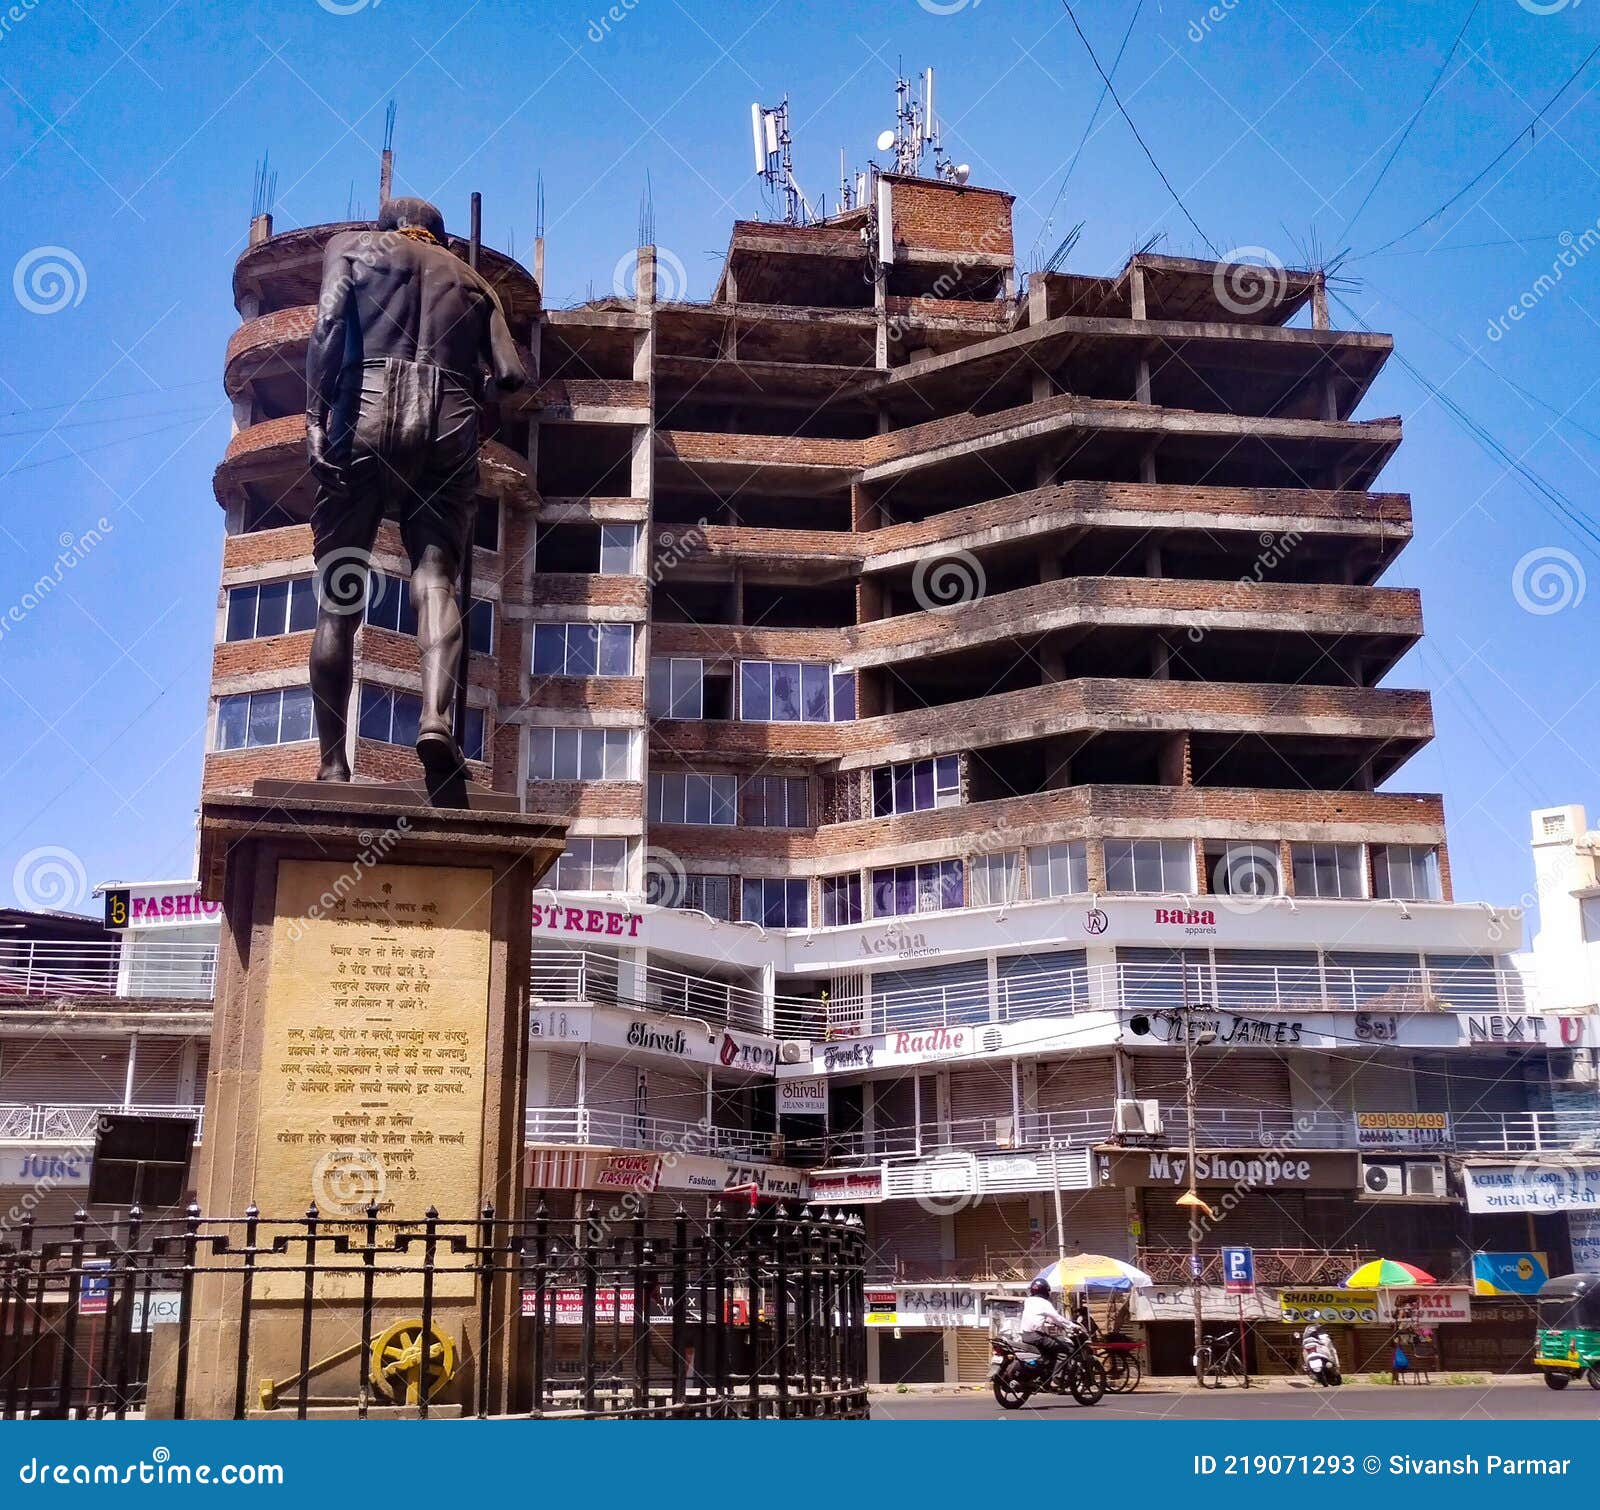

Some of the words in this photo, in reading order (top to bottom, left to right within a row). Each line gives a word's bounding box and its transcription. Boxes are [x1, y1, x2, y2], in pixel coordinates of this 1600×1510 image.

[132, 894, 222, 918] FASHIO
[532, 904, 643, 937] STREET
[1184, 926, 1217, 936] apparels
[899, 947, 940, 959] collection
[1469, 1016, 1543, 1039] NEXT
[895, 1027, 964, 1056] Radhe
[782, 1081, 825, 1098] Shivali
[1359, 1114, 1386, 1127] 299
[1388, 1114, 1415, 1127] 399
[1417, 1113, 1444, 1127] 499
[1149, 1153, 1186, 1184] My
[1195, 1153, 1310, 1186] Shoppee
[688, 1175, 717, 1186] Fashion
[1230, 1252, 1246, 1271] P
[904, 1291, 976, 1312] FASHIO
[1283, 1293, 1334, 1303] SHARAD
